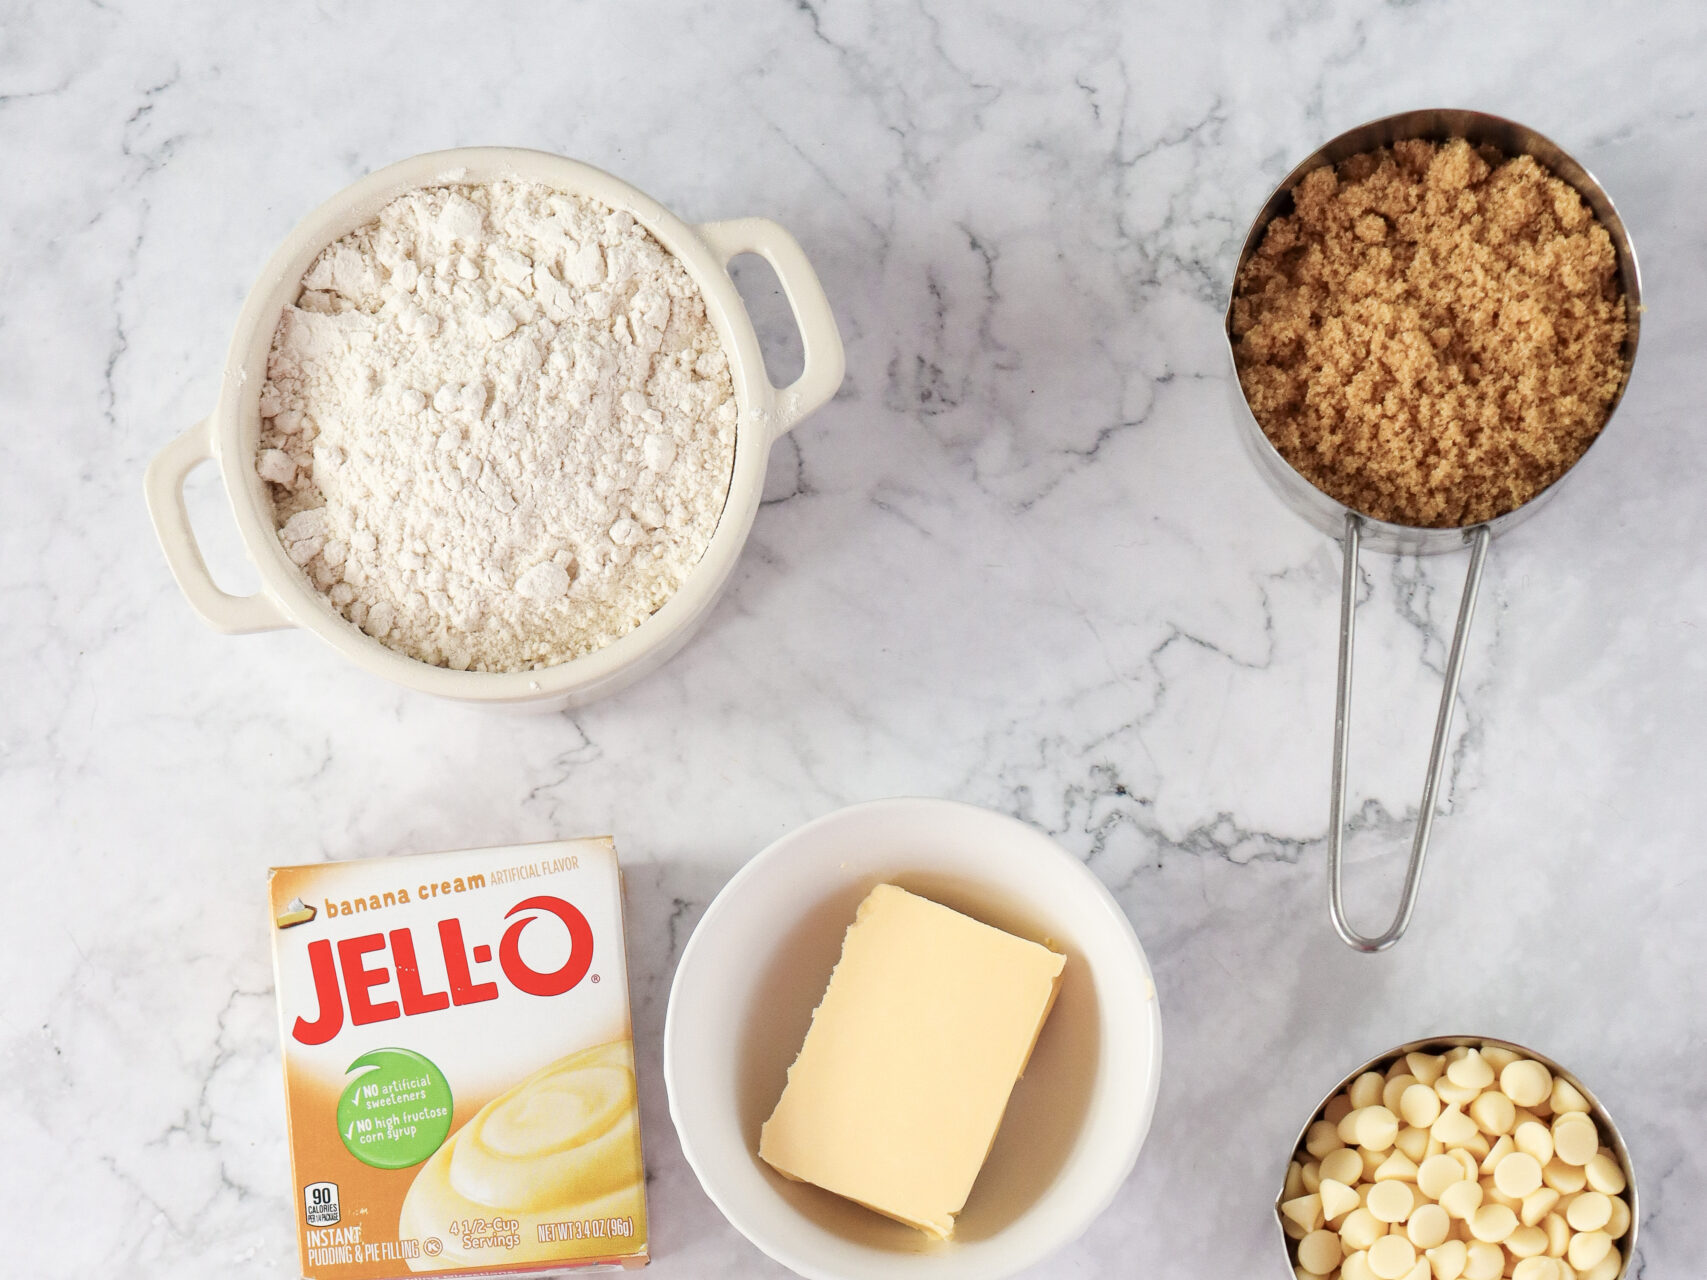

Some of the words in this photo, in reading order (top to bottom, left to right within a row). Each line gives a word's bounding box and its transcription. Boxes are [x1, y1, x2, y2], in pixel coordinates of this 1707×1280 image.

[324, 888, 411, 919] banana
[418, 874, 486, 901] cream
[490, 864, 541, 886] ARTIFICIAL
[541, 855, 579, 878] FLAVOR
[292, 895, 594, 1045] JELL-O
[363, 1084, 379, 1098] NO
[382, 1074, 431, 1094] artificial
[366, 1090, 426, 1110] sweeteners
[356, 1119, 372, 1133] NO
[374, 1114, 400, 1131] high
[403, 1107, 448, 1124] fructose
[360, 1131, 384, 1144] corn
[387, 1125, 417, 1142] syrup
[312, 1187, 331, 1205] 90
[307, 1204, 338, 1215] CALORIES
[308, 1214, 316, 1223] PER
[450, 1221, 459, 1235] 4
[462, 1217, 519, 1235] 1/2-Cup
[538, 1223, 557, 1243] NET
[557, 1221, 574, 1241] WT
[575, 1220, 590, 1239] 3.4
[592, 1219, 605, 1237] OZ
[606, 1216, 634, 1238] (96g)
[306, 1226, 361, 1248] INSTANT
[463, 1233, 520, 1249] Servings
[308, 1245, 352, 1267] PUDDING
[355, 1244, 364, 1264] &
[365, 1243, 380, 1262] PIE
[381, 1239, 420, 1261] FILLING
